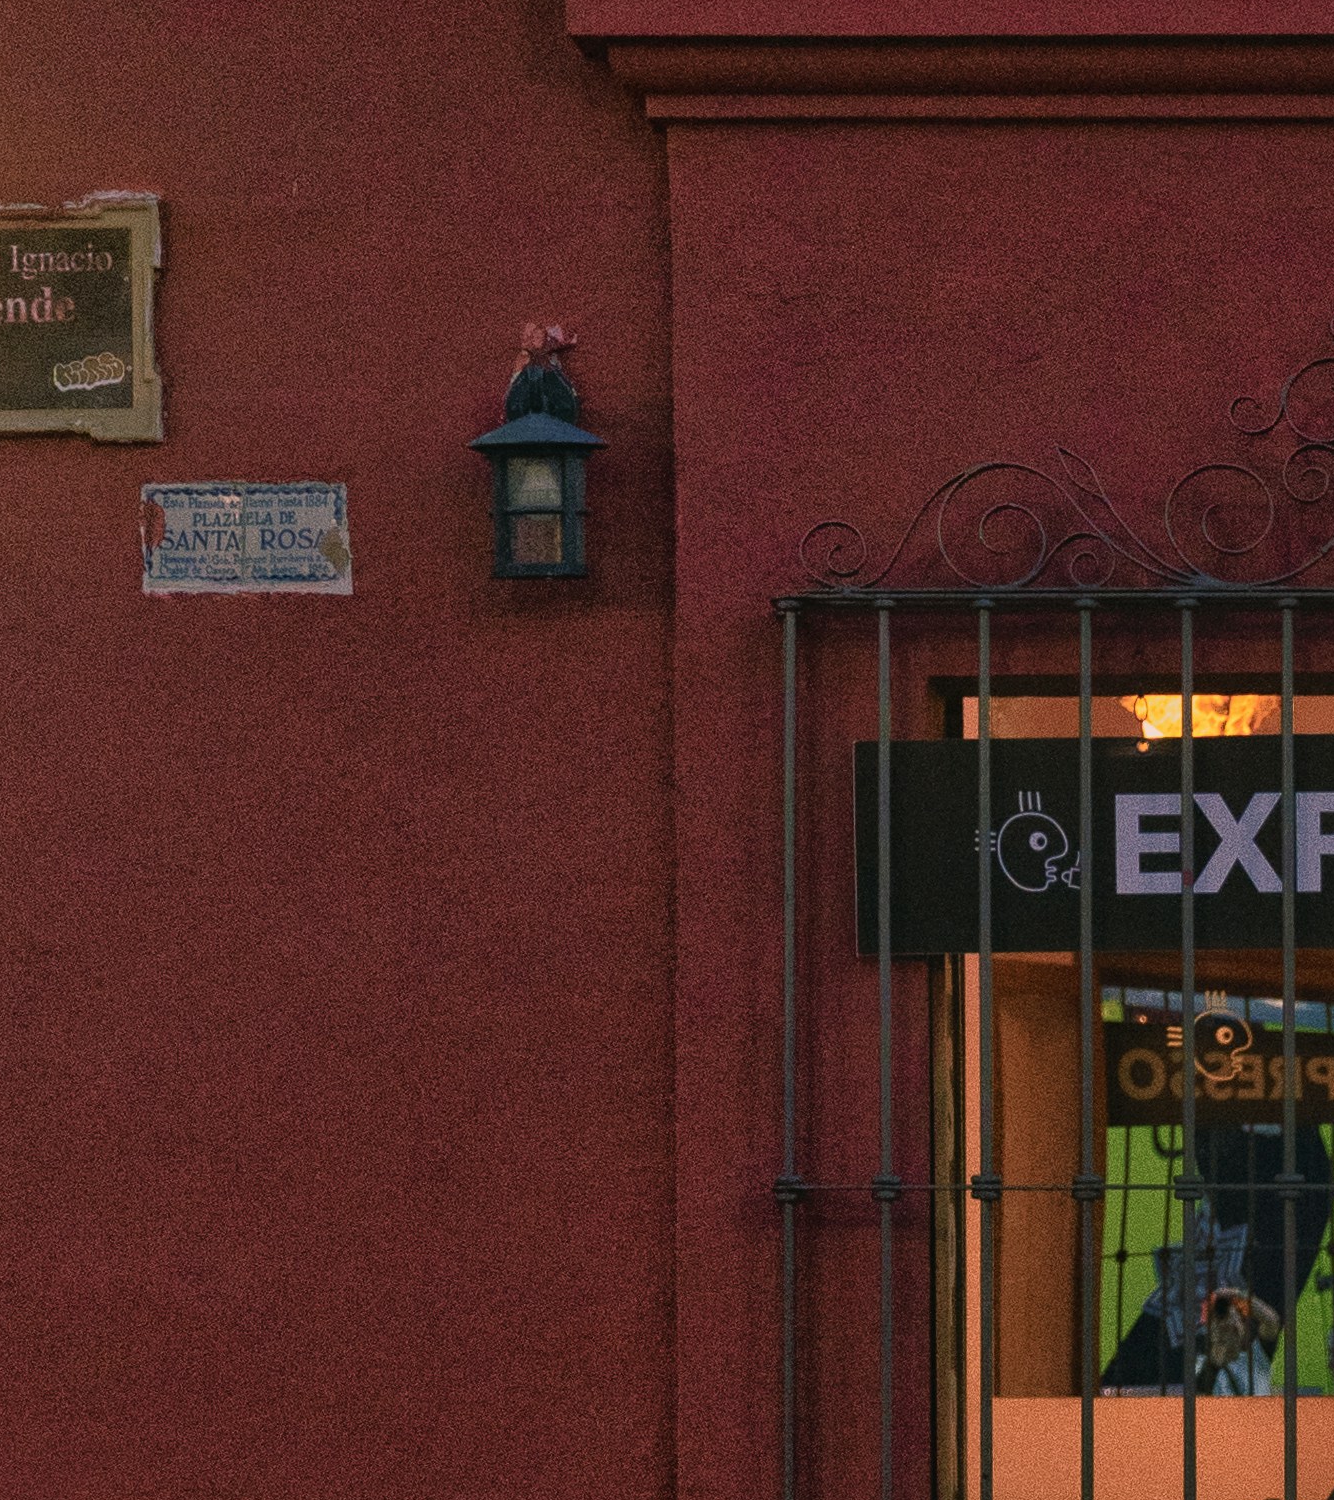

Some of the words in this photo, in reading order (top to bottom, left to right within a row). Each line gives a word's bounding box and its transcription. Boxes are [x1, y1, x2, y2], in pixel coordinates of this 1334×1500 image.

[11, 243, 114, 280] Ignacio
[192, 512, 274, 527] PLAZUELA
[279, 511, 297, 525] DE
[161, 529, 241, 552] SANTA
